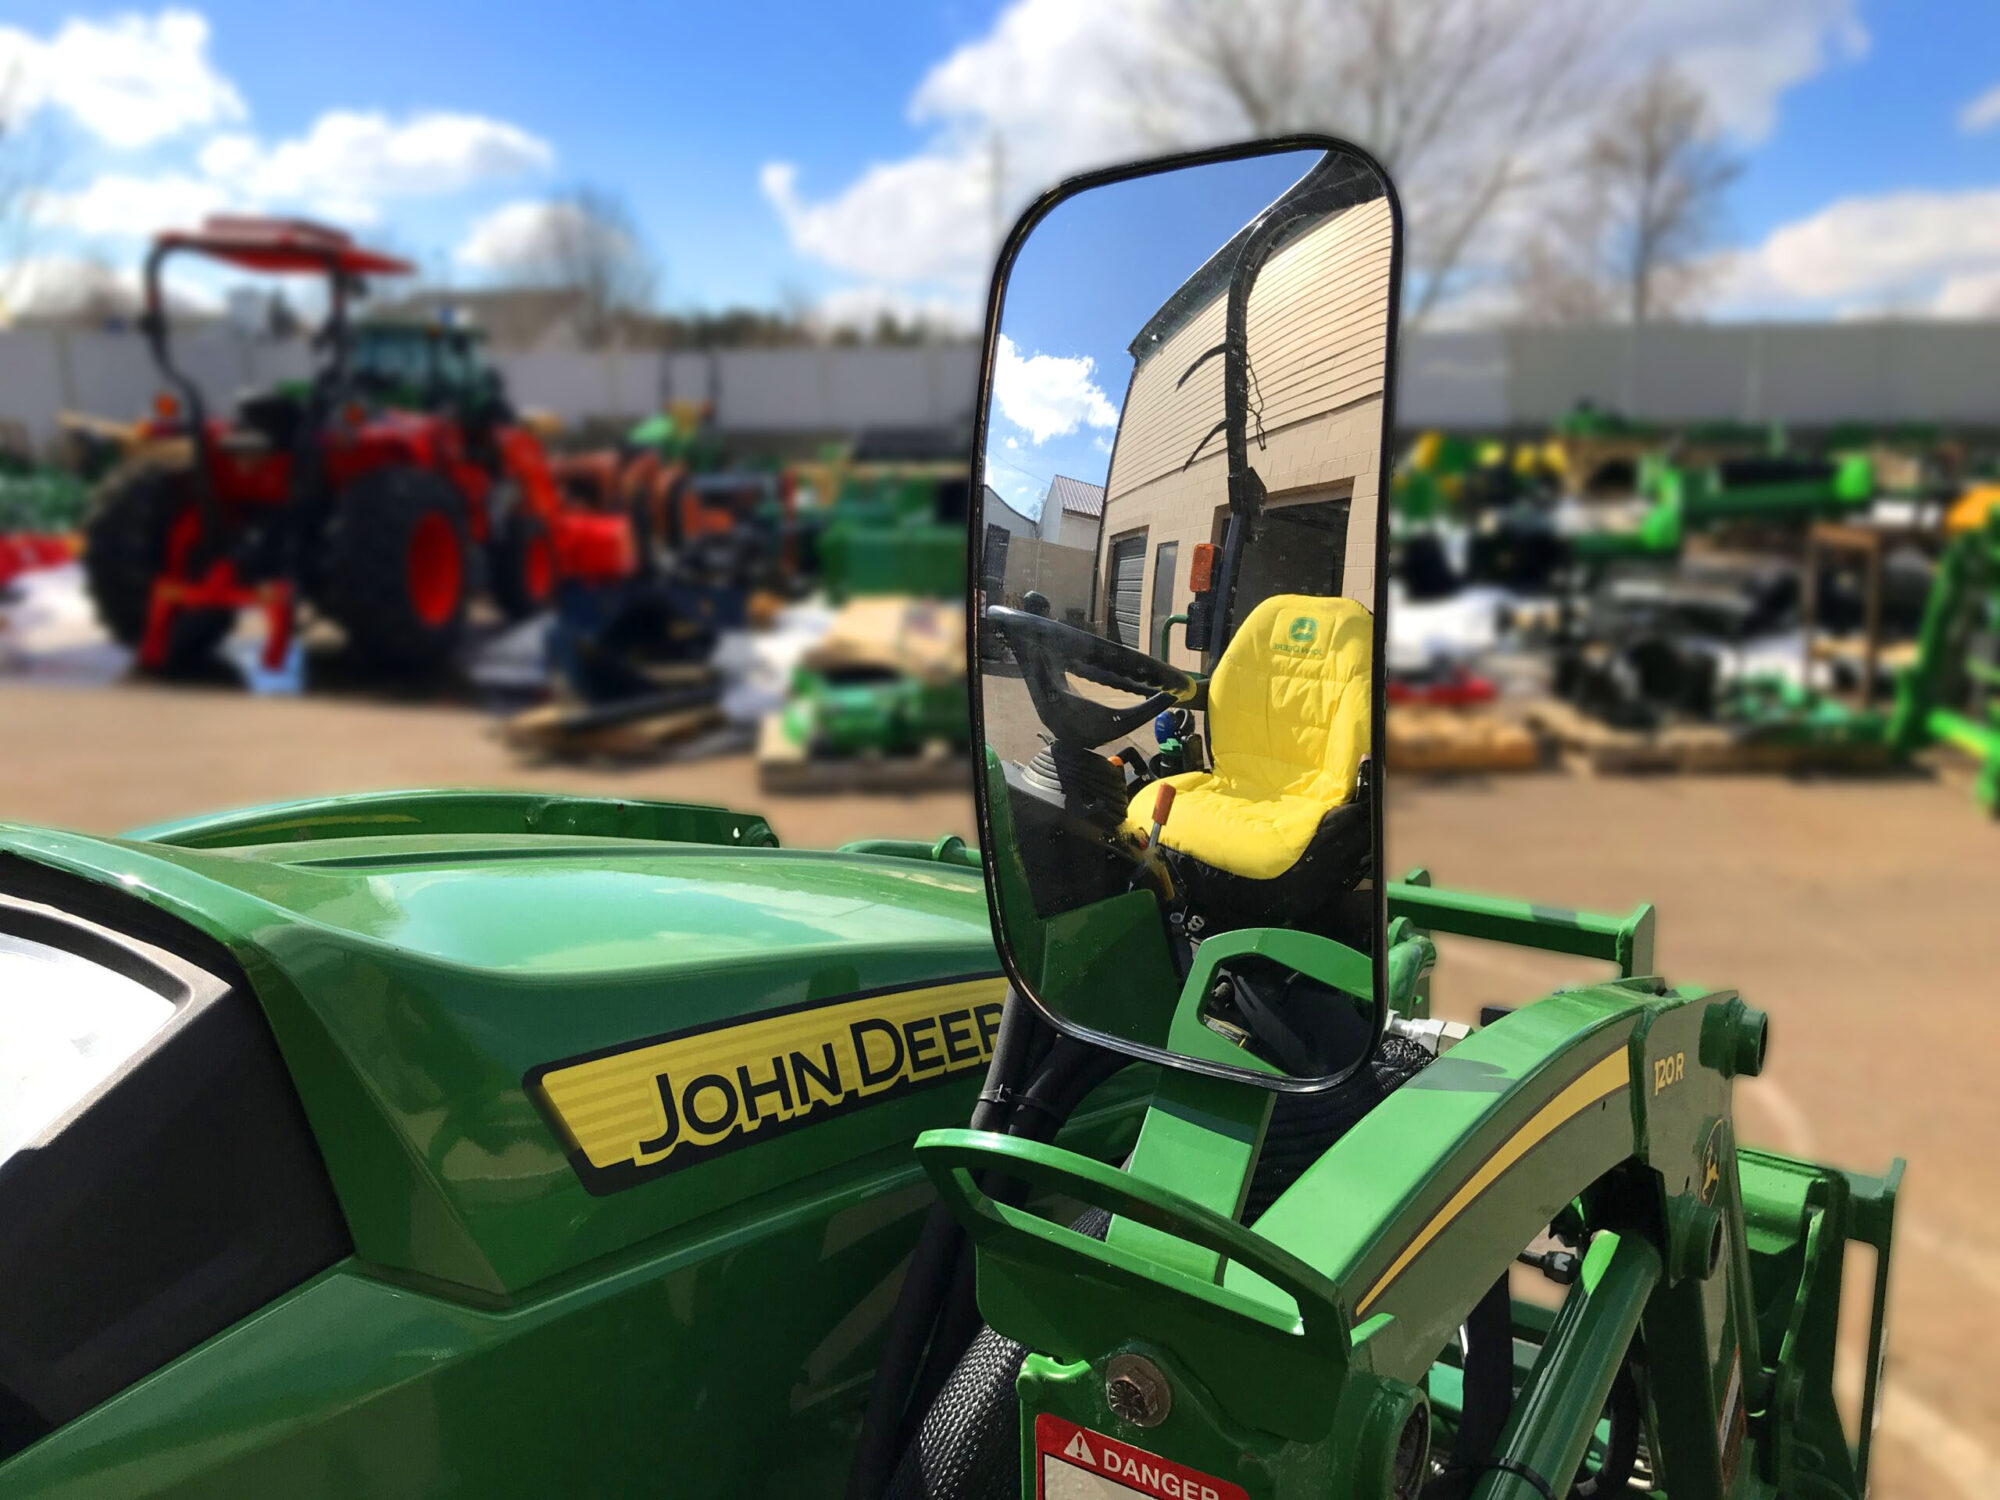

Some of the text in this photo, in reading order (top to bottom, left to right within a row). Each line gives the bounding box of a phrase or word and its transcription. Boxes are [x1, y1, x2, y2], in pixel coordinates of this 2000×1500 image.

[638, 1043, 845, 1156] JOHN
[1654, 1052, 1684, 1096] 120R
[1103, 1448, 1219, 1500] DANGER
